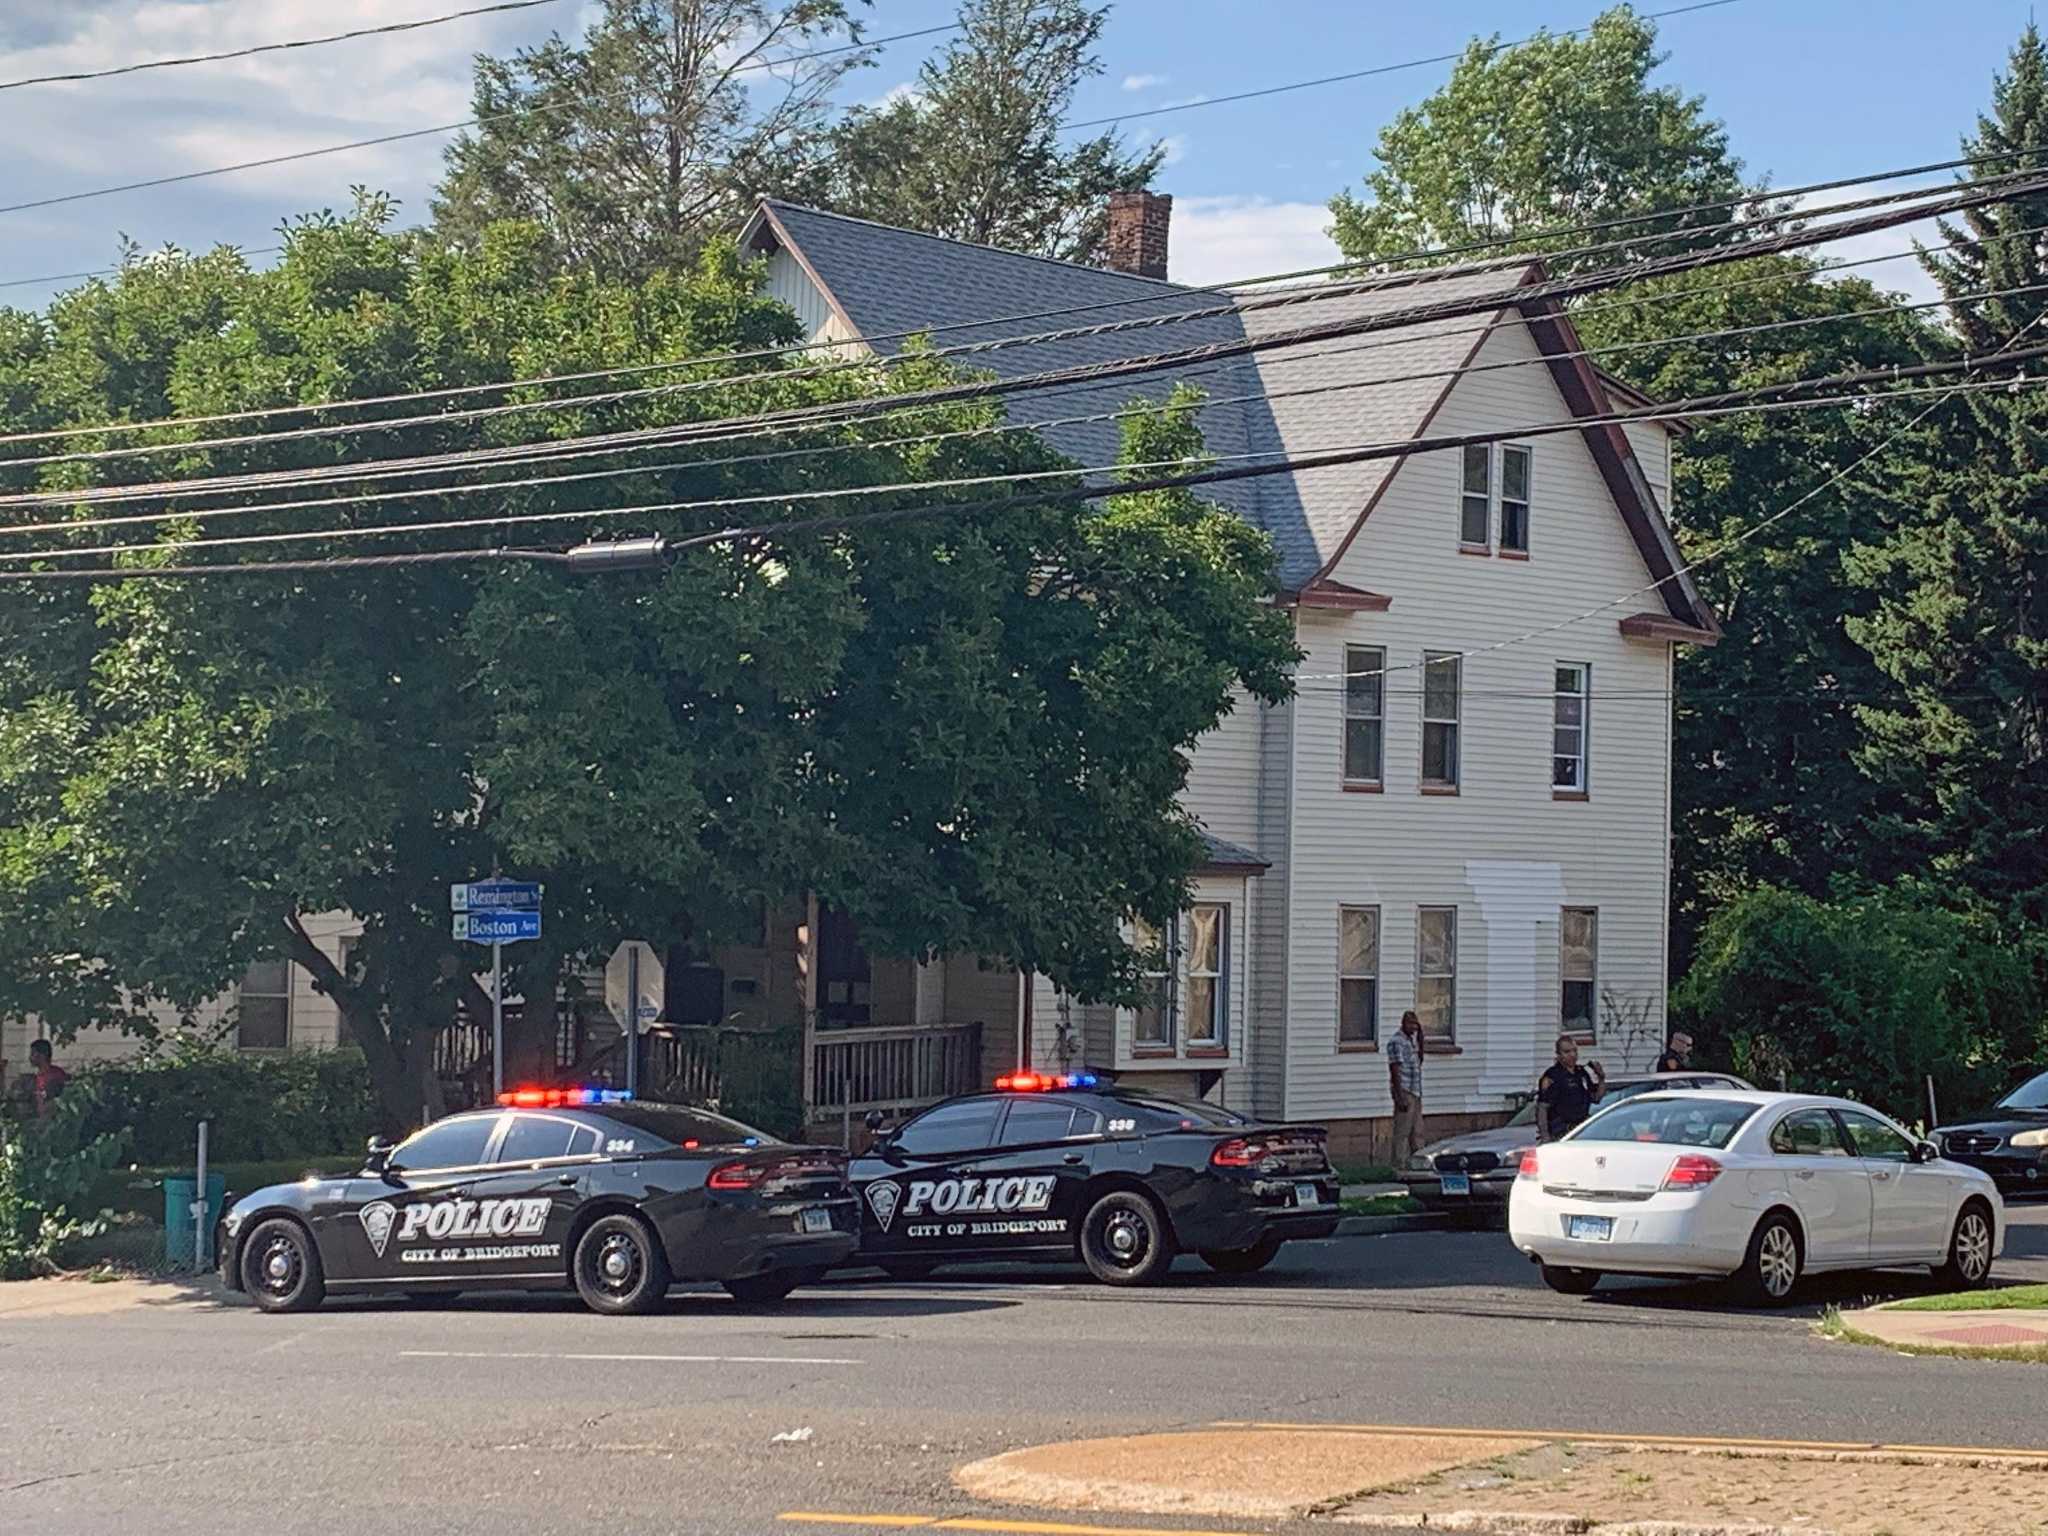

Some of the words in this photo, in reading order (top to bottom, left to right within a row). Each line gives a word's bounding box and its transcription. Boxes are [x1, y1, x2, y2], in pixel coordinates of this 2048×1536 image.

[469, 887, 529, 909] Remington
[470, 917, 517, 935] Boston
[521, 920, 537, 931] Ave
[902, 1176, 1057, 1216] POLICE
[397, 1198, 552, 1240] POLICE
[907, 1224, 943, 1237] CITY
[947, 1223, 967, 1236] OF
[971, 1219, 1068, 1235] BRIDGEPORT
[401, 1248, 437, 1262] CITY
[441, 1247, 461, 1261] OF
[465, 1244, 561, 1260] BRIDGEPORT
